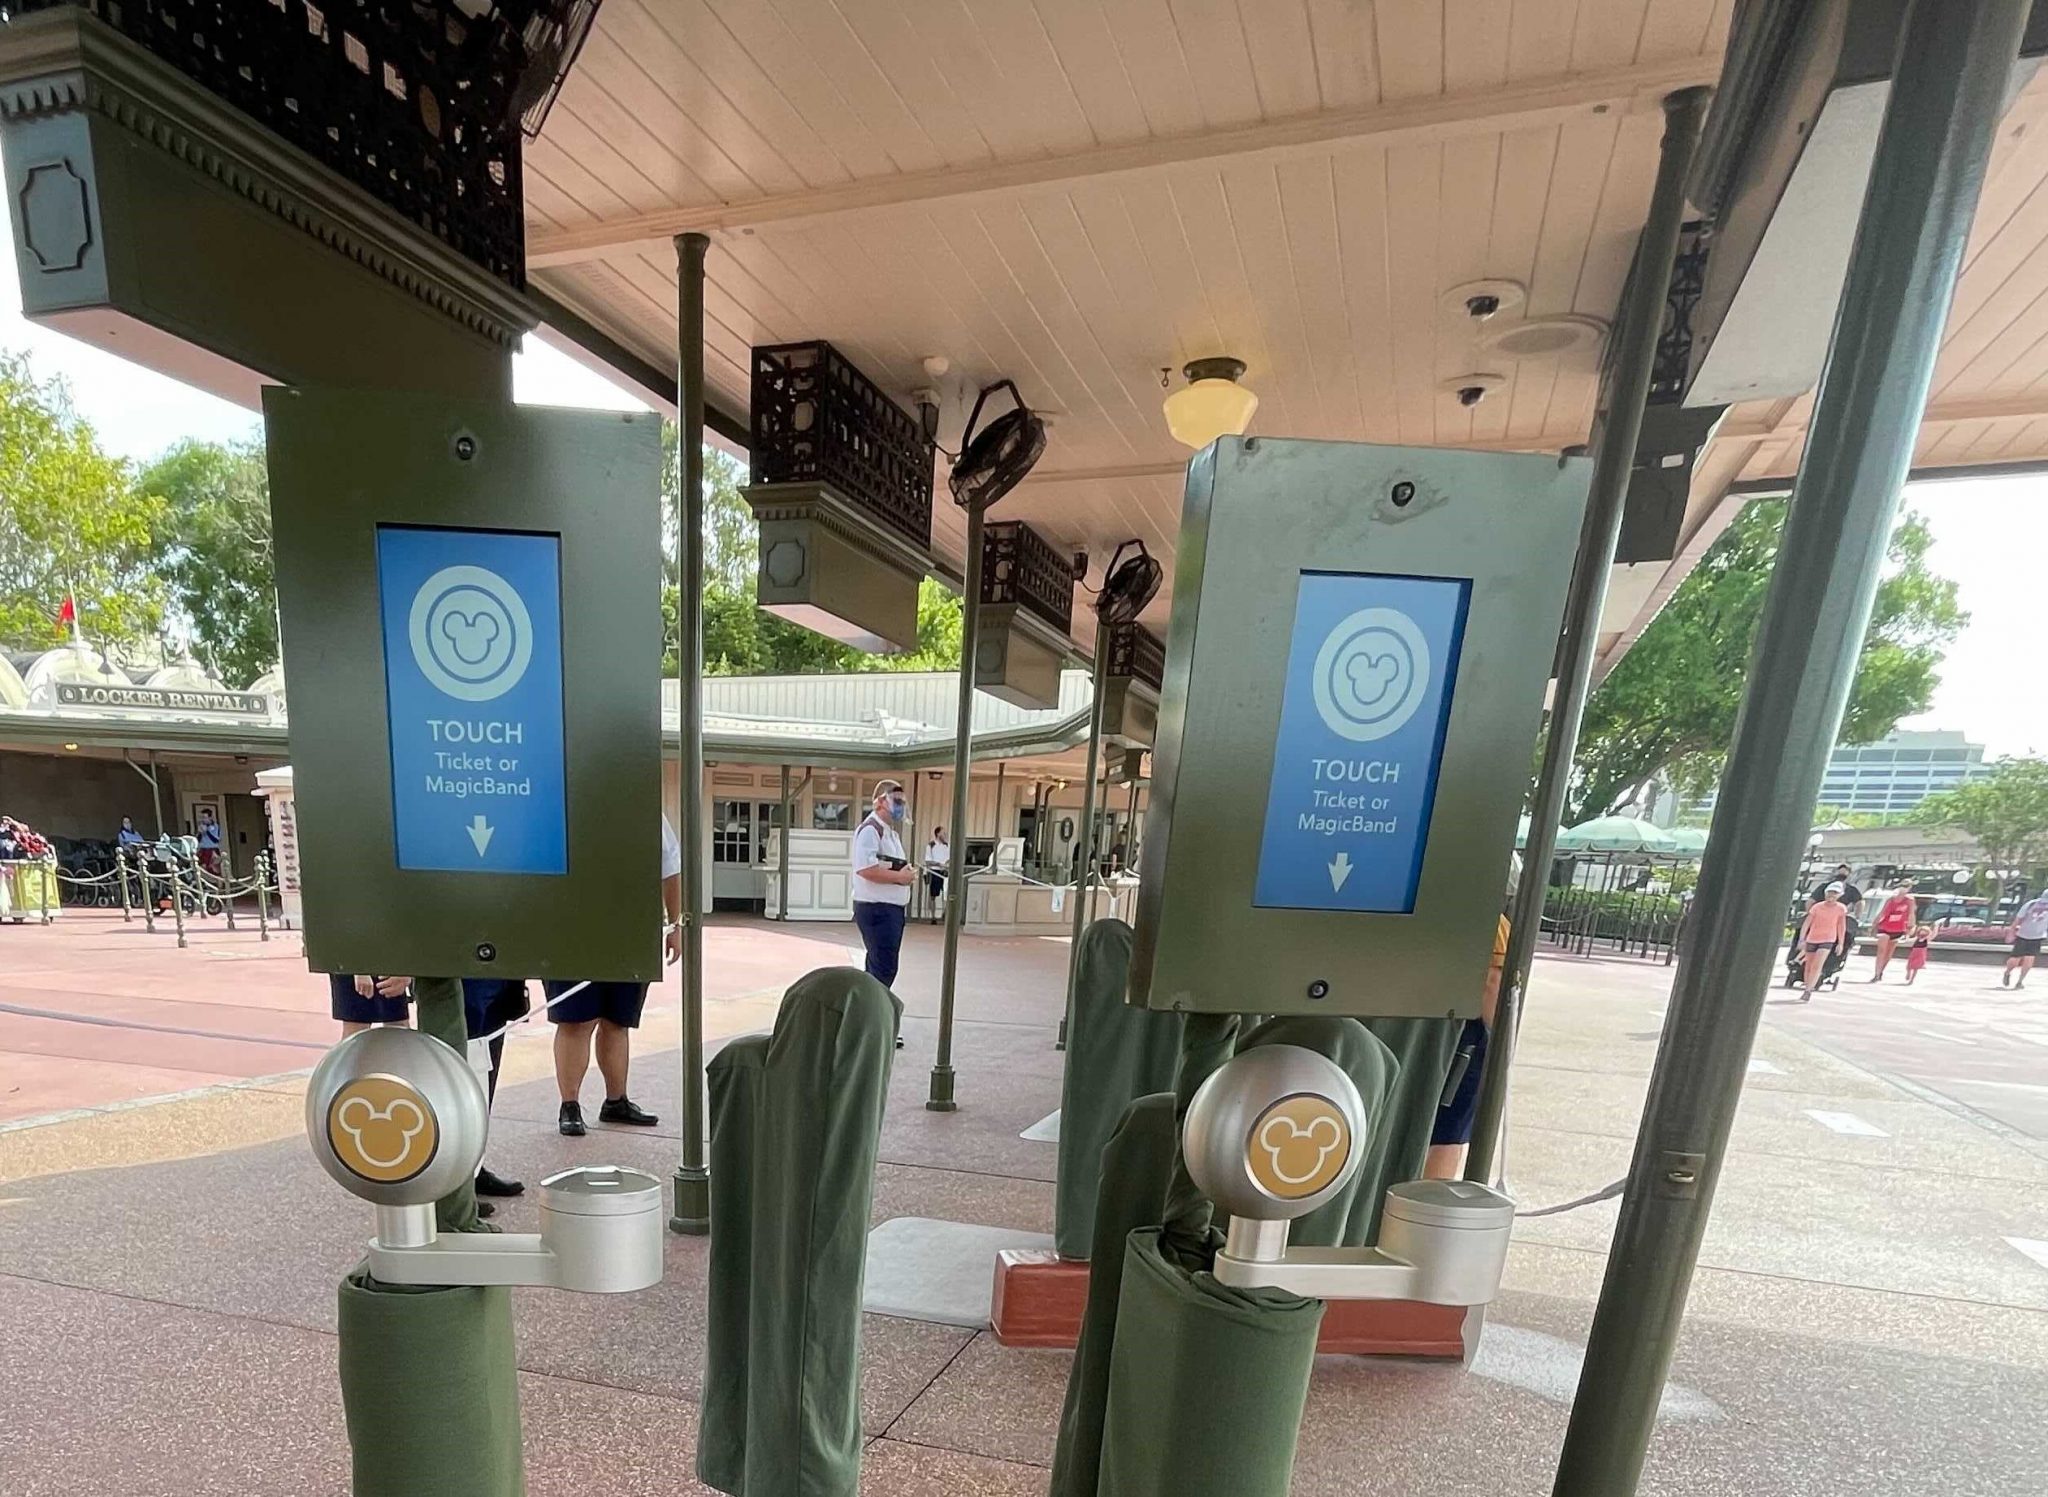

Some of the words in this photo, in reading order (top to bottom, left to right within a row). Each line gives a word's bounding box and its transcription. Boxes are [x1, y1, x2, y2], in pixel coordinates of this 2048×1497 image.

[79, 687, 165, 707] LOCKER
[167, 693, 247, 711] RENTAL
[426, 720, 522, 744] TOUCH
[434, 752, 492, 771] Ticket
[499, 758, 519, 772] or
[1312, 759, 1400, 783] TOUCH
[425, 776, 530, 798] MagicBand
[1312, 790, 1366, 810] Ticket
[1371, 798, 1390, 810] or
[1298, 813, 1397, 835] MagicBand
